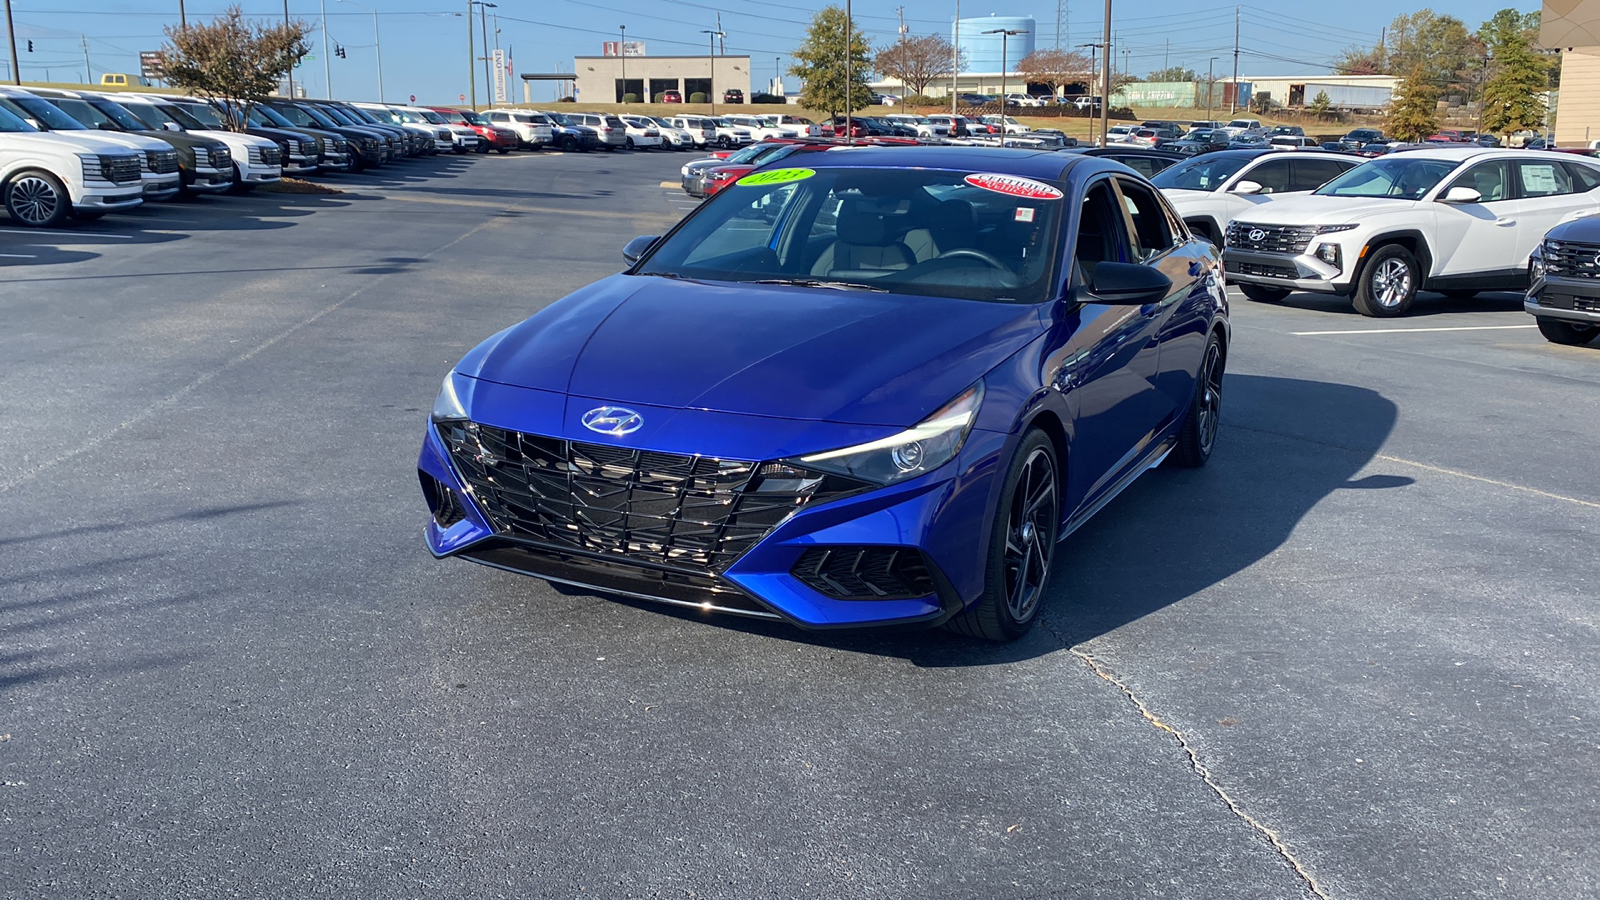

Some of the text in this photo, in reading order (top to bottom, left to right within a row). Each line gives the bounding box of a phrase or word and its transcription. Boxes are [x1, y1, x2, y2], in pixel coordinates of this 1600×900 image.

[1147, 90, 1175, 99] SHIPPING
[746, 170, 805, 183] 2023
[979, 175, 1053, 193] CERTIFIED
